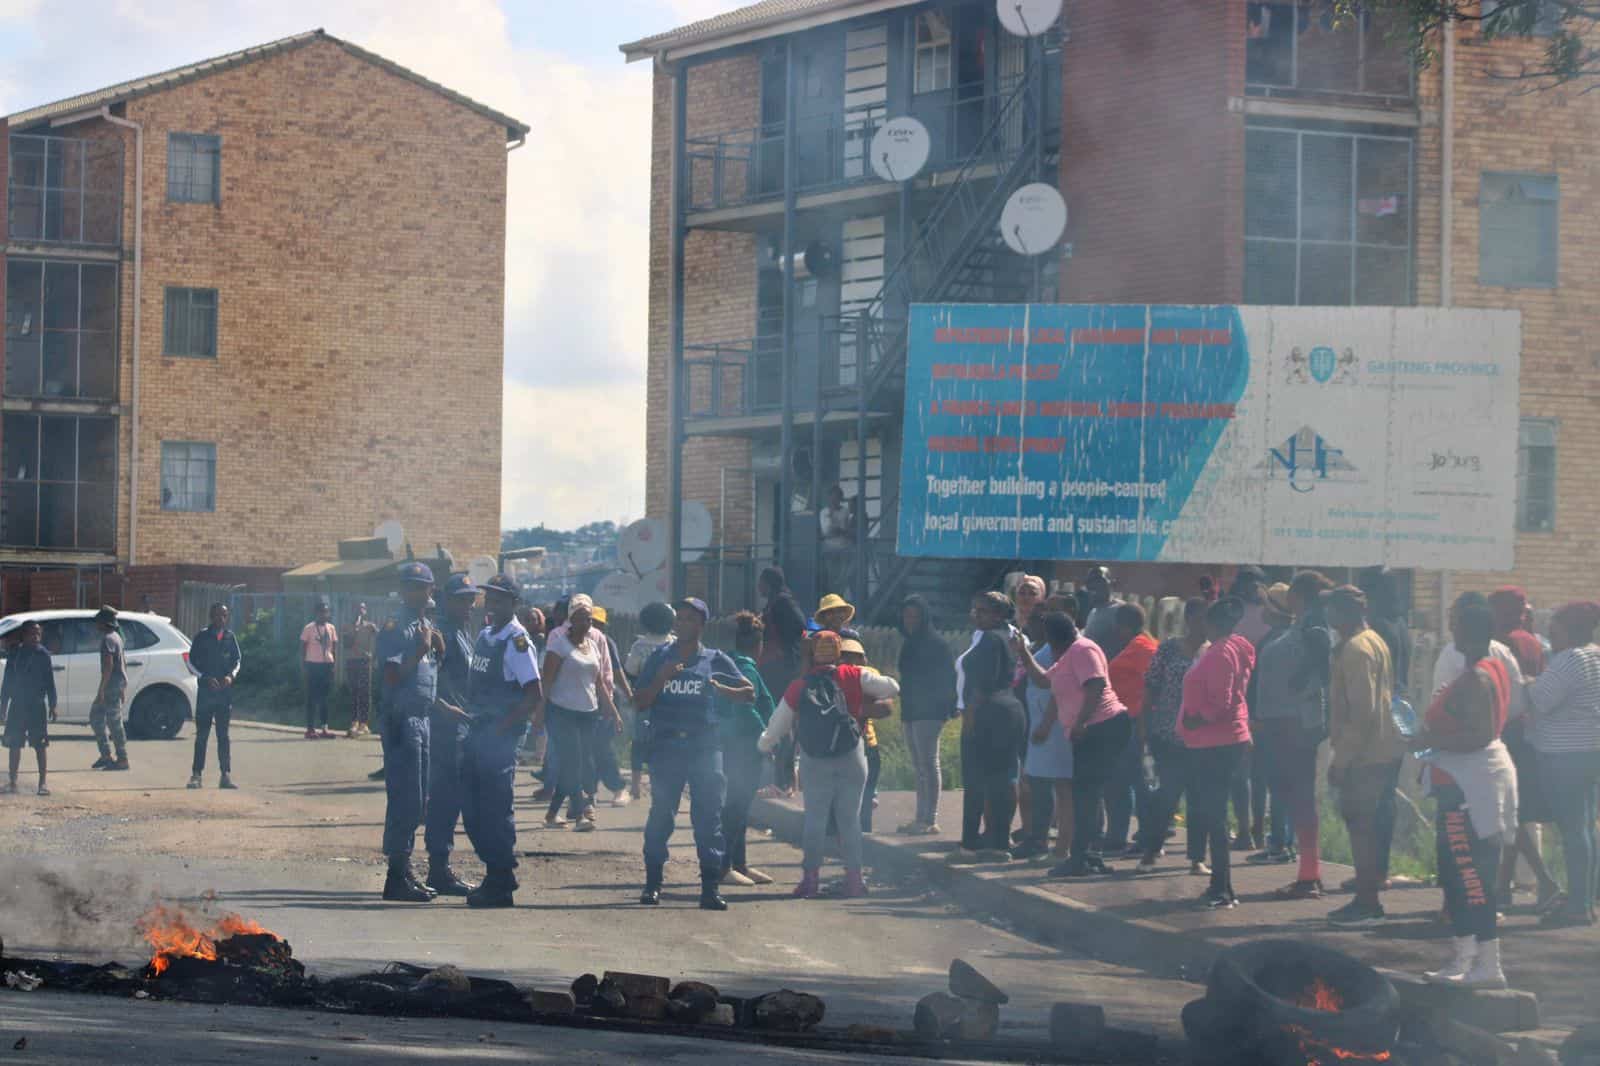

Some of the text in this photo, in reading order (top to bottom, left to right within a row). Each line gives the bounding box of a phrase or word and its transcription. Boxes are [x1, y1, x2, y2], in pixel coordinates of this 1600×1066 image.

[926, 474, 985, 498] Together
[989, 476, 1045, 500] building
[1048, 480, 1057, 497] a
[925, 511, 959, 531] local
[962, 513, 1044, 536] government
[1047, 514, 1073, 533] and
[663, 679, 703, 695] POLICE
[1461, 868, 1487, 904] MOVE
